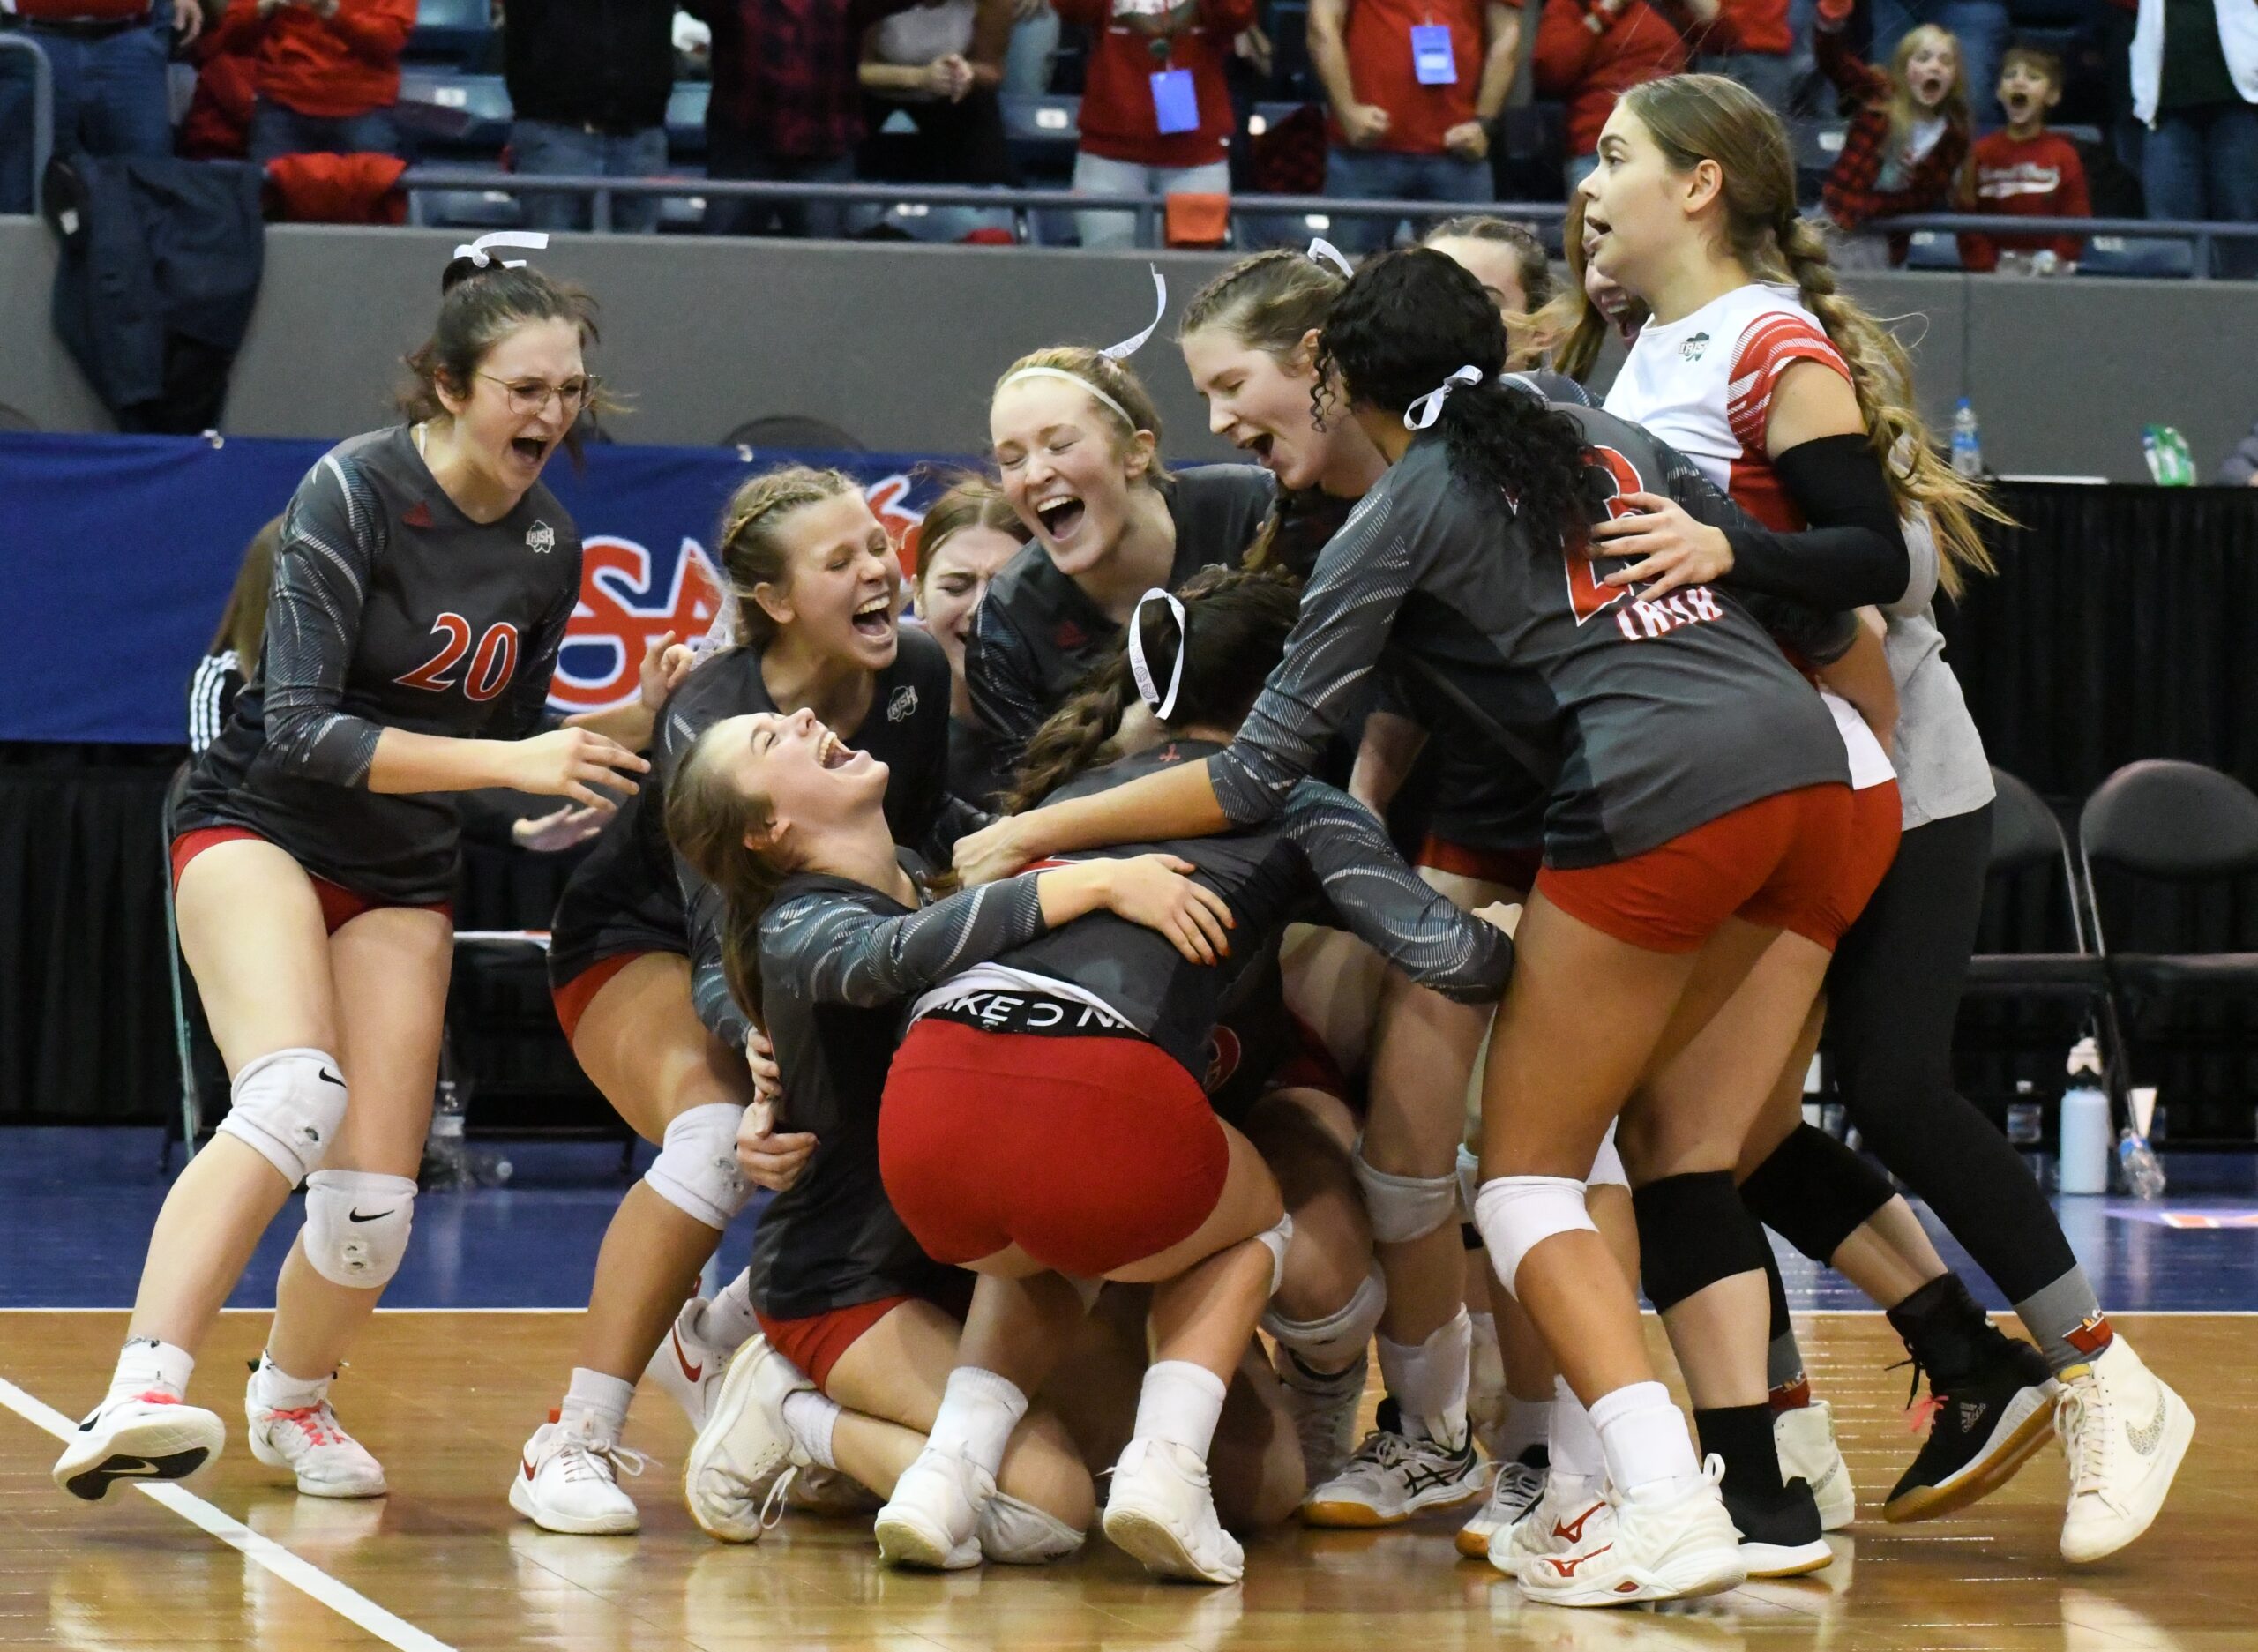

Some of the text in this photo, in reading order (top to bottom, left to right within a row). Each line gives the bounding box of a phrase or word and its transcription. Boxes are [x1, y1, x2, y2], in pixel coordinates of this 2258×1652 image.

[526, 527, 555, 545] IRISH
[391, 611, 519, 702] 20
[886, 685, 919, 721] IRISH
